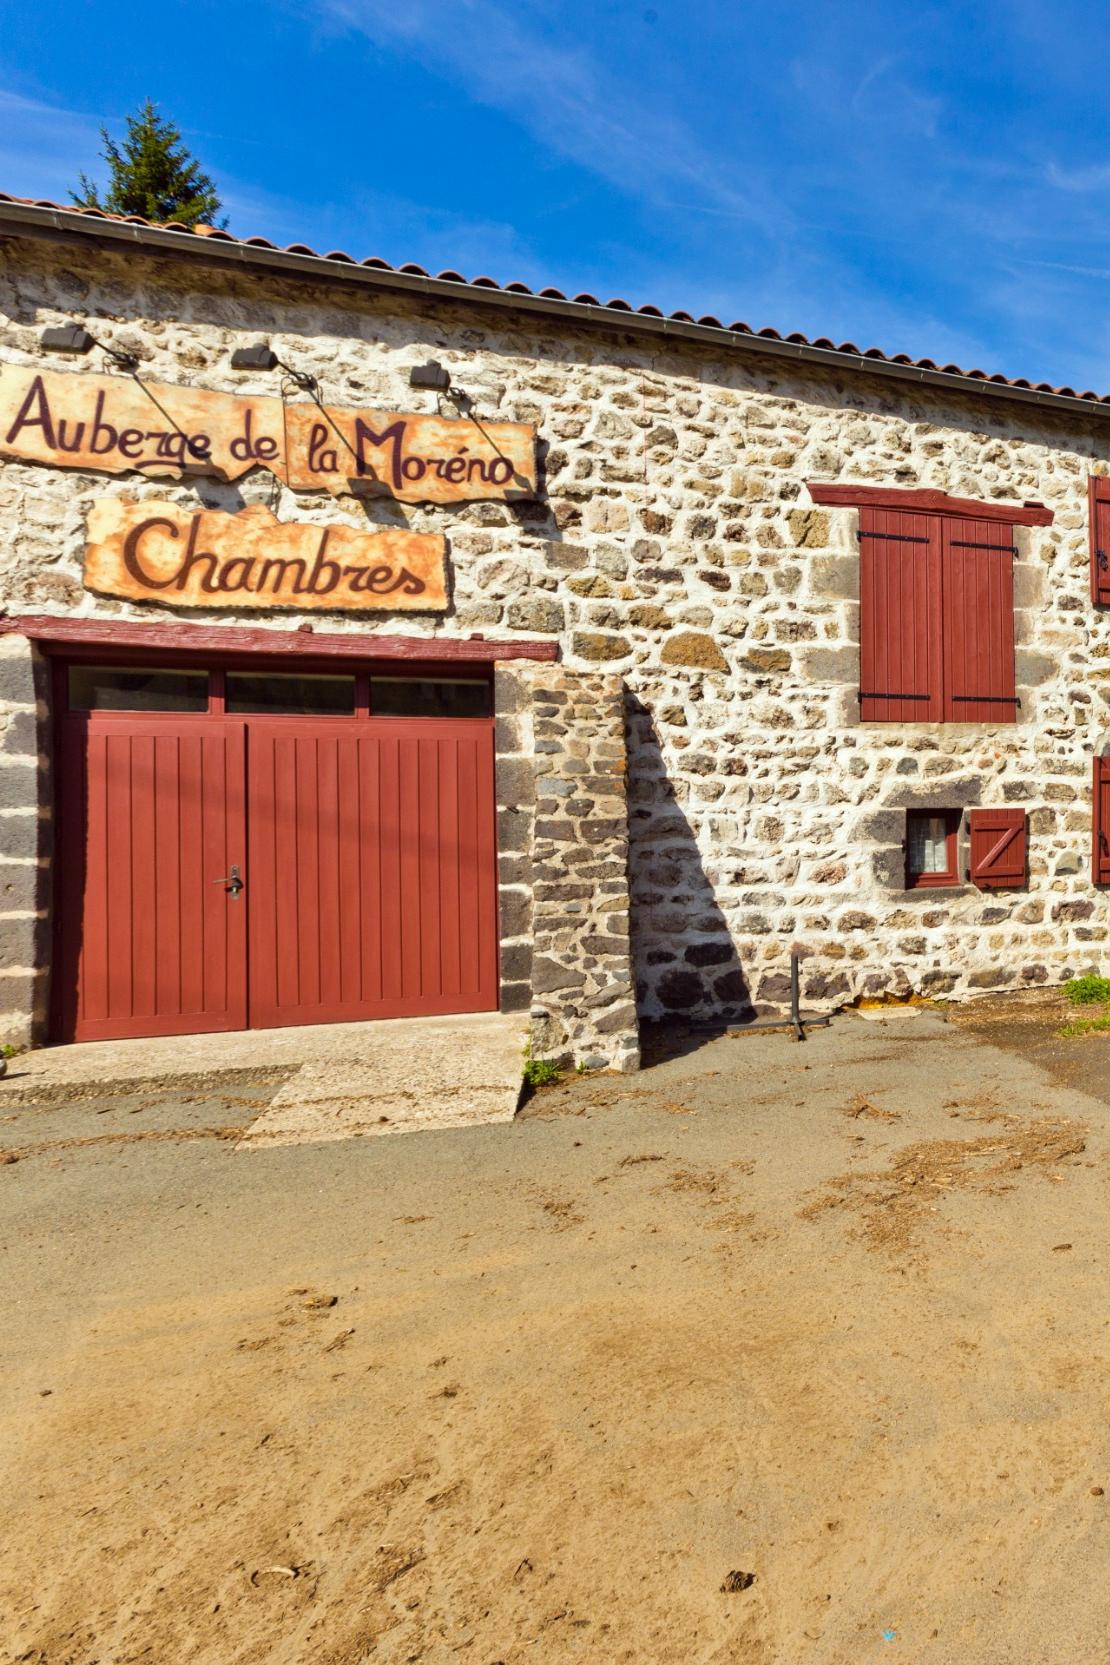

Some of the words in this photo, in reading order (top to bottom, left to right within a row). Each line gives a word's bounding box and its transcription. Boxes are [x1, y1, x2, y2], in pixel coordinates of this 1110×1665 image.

[6, 375, 212, 469] Auberge
[230, 409, 280, 461] de
[308, 423, 339, 474] la
[355, 417, 515, 490] Moréno
[124, 513, 426, 596] Chambres
